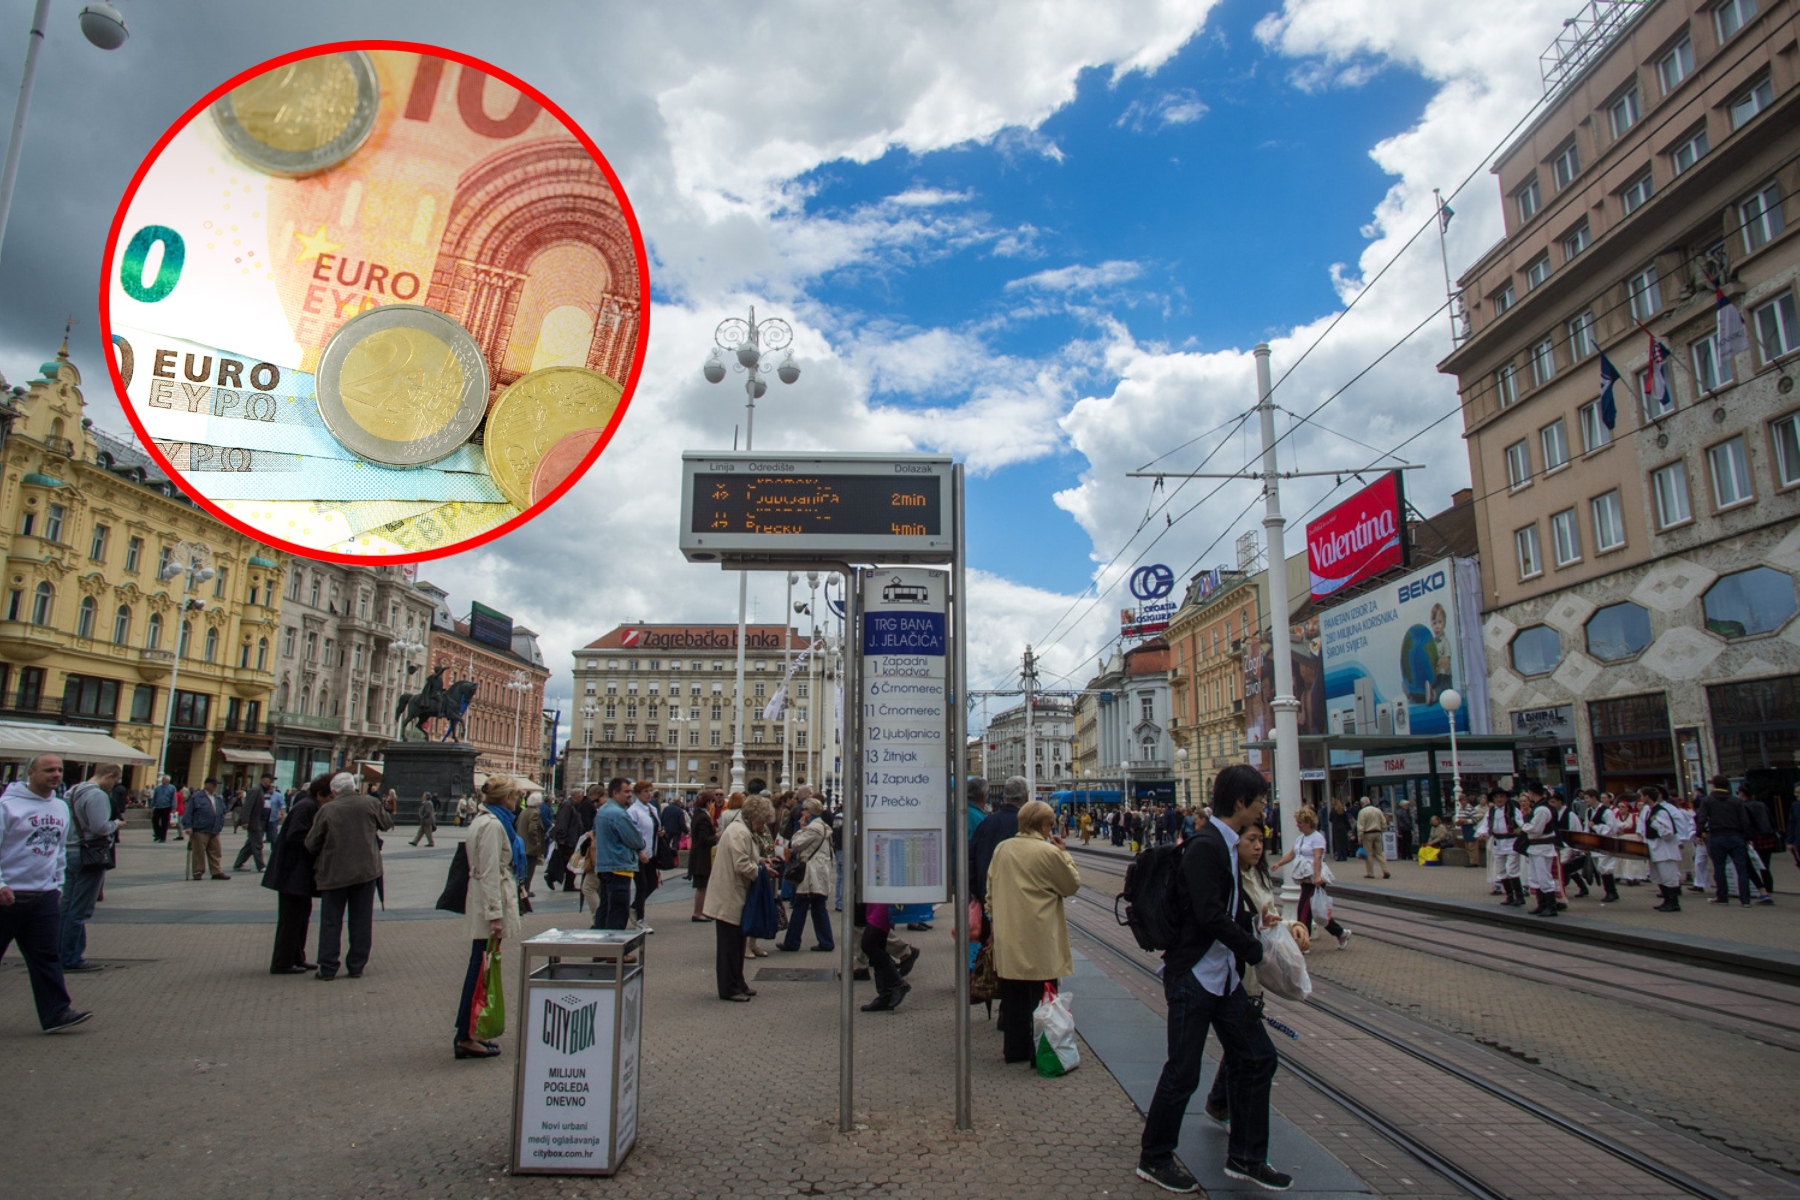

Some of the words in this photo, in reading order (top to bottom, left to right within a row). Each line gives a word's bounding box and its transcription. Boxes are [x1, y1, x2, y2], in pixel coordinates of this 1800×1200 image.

[710, 463, 735, 473] Linija
[748, 462, 795, 472] Odredište
[894, 463, 933, 473] Dolazak
[891, 493, 926, 506] 2min
[891, 522, 926, 535] 4min
[1310, 509, 1395, 571] Valentina
[1398, 570, 1446, 604] BEKO
[1143, 602, 1177, 613] CROATIA
[1324, 610, 1351, 630] PAMETAN
[1351, 604, 1369, 620] IZBOR
[1369, 600, 1378, 613] ZA
[1363, 608, 1399, 631] KORISNIKA
[874, 618, 897, 631] TRG
[900, 618, 934, 632] BANA
[643, 629, 729, 650] Zagrebačka
[881, 631, 939, 648] JELAČIĆA
[882, 656, 928, 668] Zapadni
[882, 666, 930, 677] kolodvor
[870, 682, 880, 695] 6
[881, 681, 942, 694] Črnomerec
[865, 704, 875, 717] 11
[879, 704, 940, 716] Črnomerec
[868, 727, 880, 740] 12
[883, 728, 941, 741] Ljubljanica
[865, 749, 878, 763] 13
[883, 748, 918, 763] Žitnjak
[1384, 759, 1405, 771] TISAK
[865, 772, 878, 785] 14
[865, 795, 878, 808] 17
[881, 795, 919, 807] Prečko
[28, 814, 64, 827] Tribal
[542, 999, 598, 1055] CITYBOX
[549, 1067, 586, 1079] MILIJUN
[544, 1081, 590, 1093] POGLEDA
[546, 1096, 586, 1107] DNEVNO
[541, 1121, 560, 1130] Novi
[561, 1121, 588, 1130] urbani
[528, 1135, 550, 1145] medij
[551, 1135, 600, 1145] oglašavanja
[533, 1149, 593, 1159] citybox.com.hr
